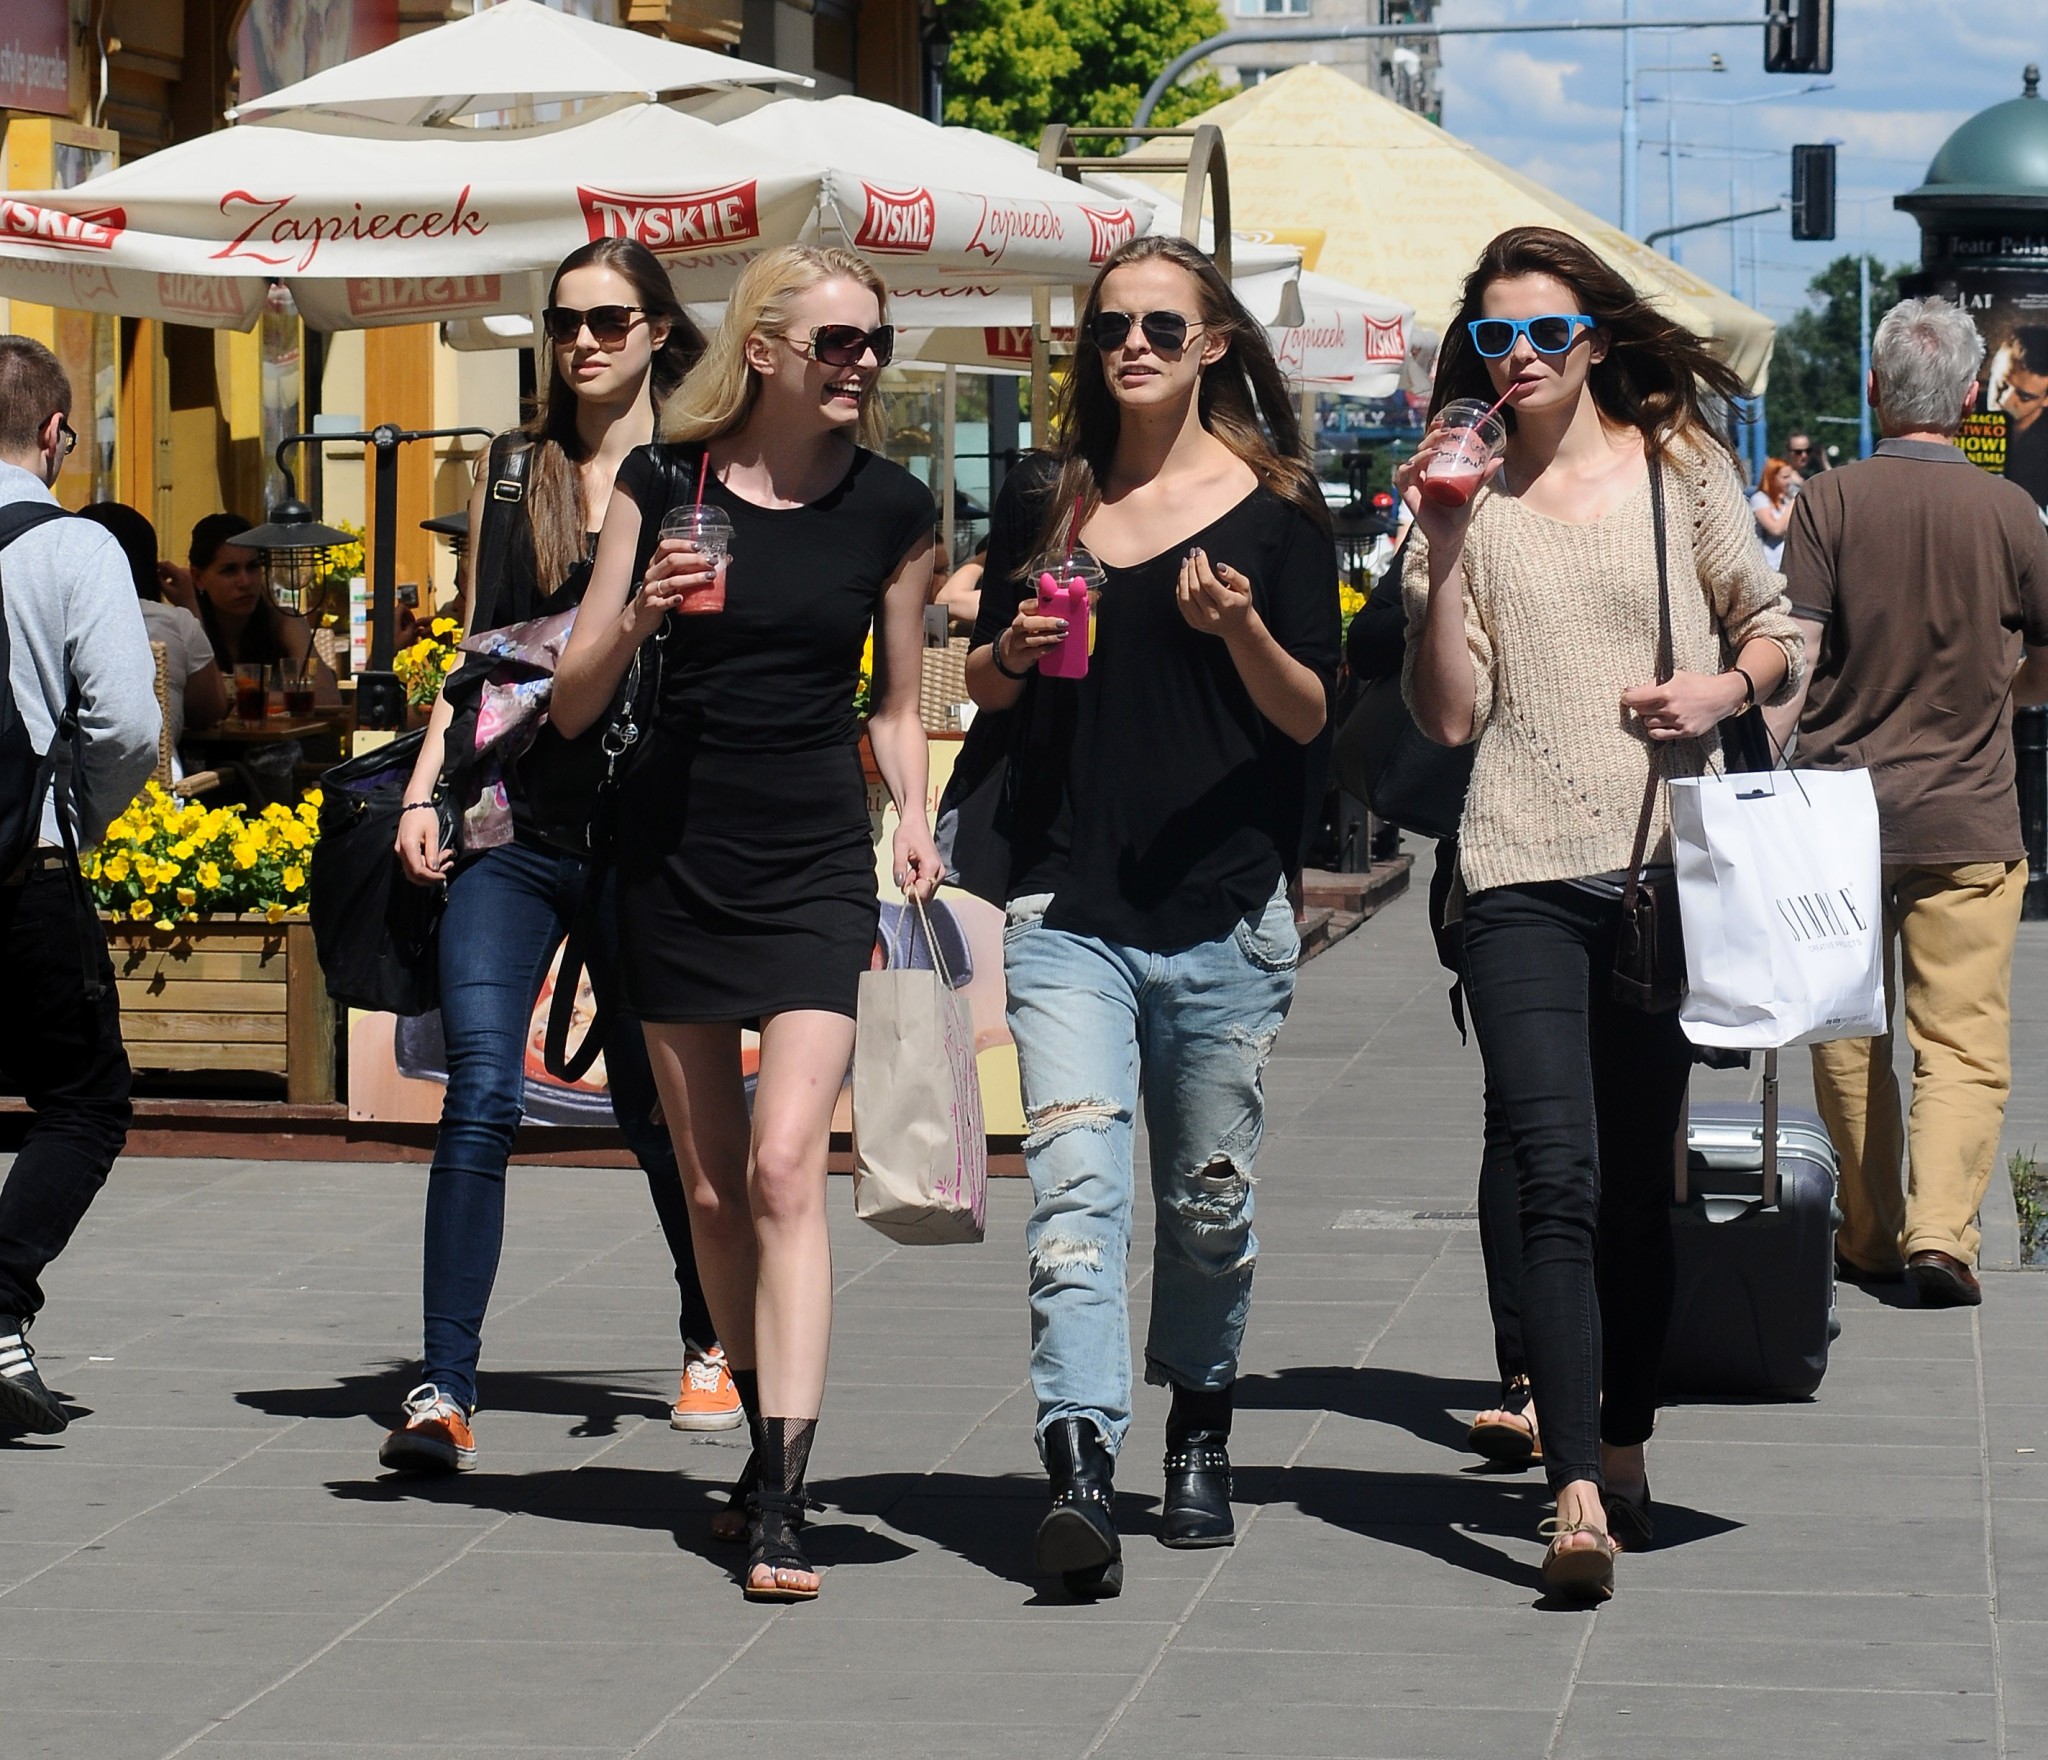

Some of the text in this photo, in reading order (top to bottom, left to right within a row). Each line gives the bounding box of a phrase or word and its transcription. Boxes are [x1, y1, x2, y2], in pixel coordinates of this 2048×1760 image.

[208, 184, 489, 272] Zapiecek
[592, 195, 750, 246] TYSKIE
[866, 194, 932, 245] TYSKIE
